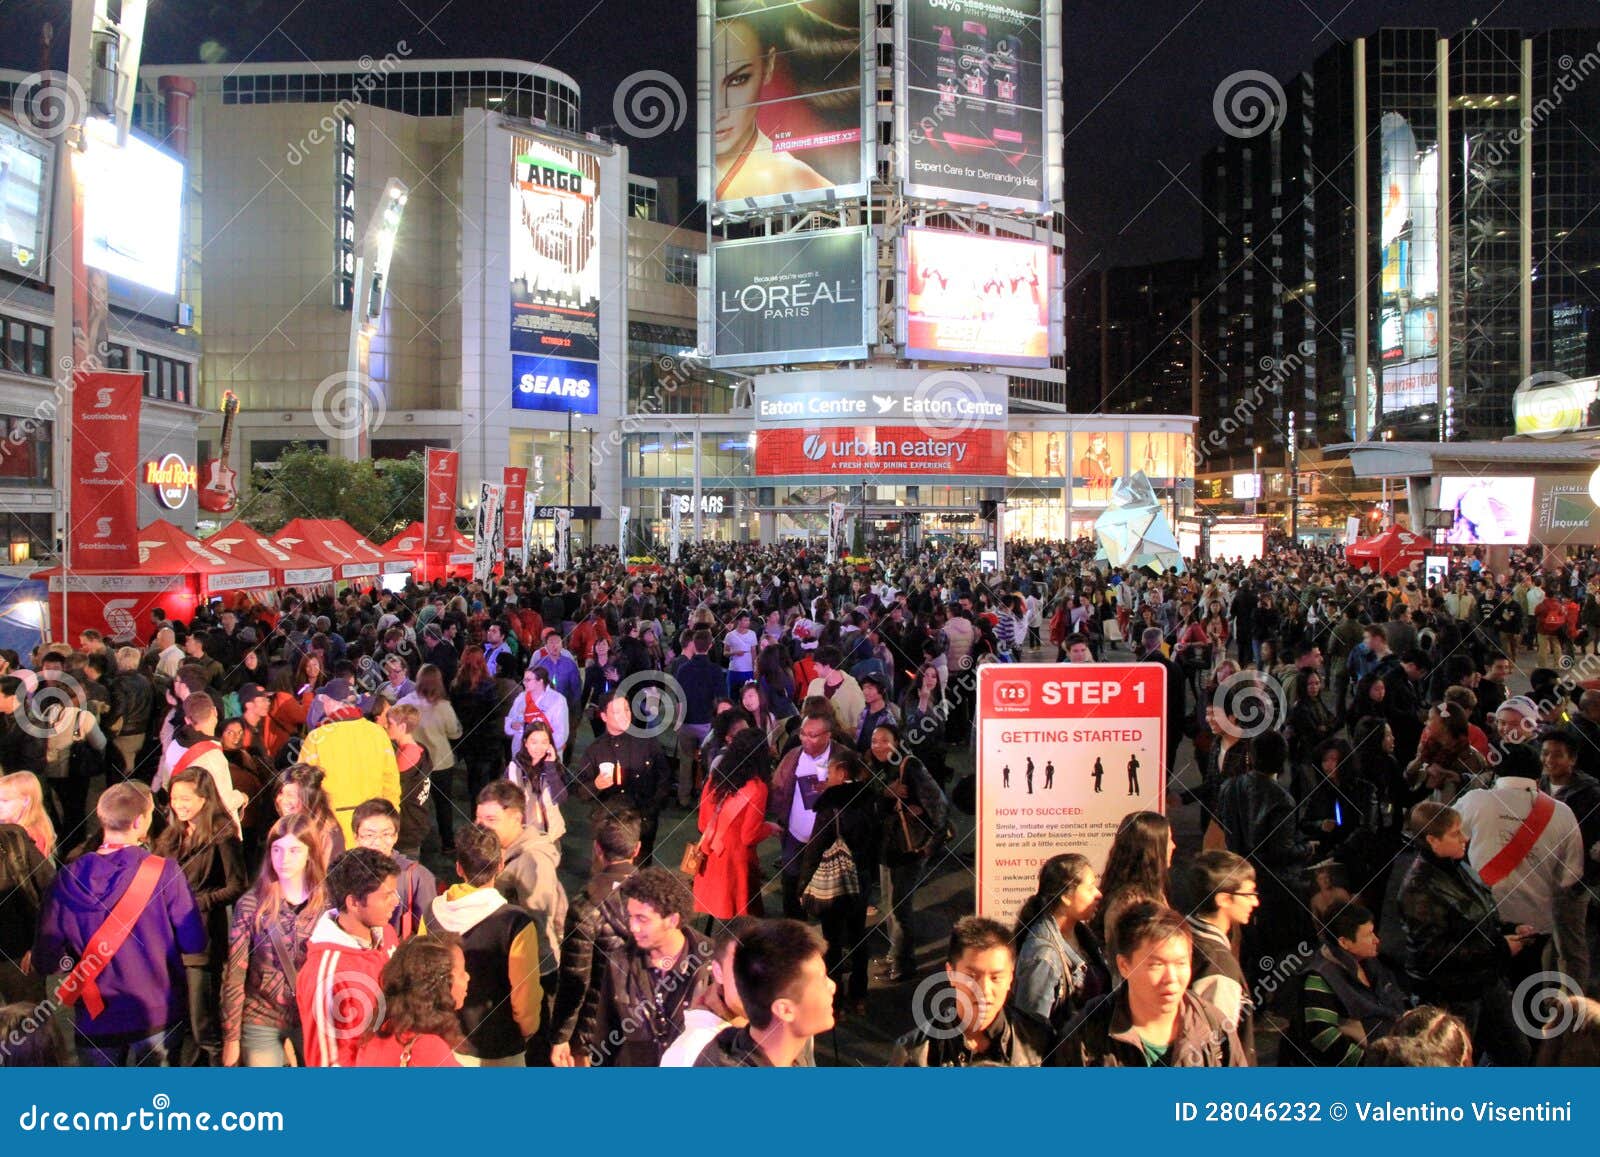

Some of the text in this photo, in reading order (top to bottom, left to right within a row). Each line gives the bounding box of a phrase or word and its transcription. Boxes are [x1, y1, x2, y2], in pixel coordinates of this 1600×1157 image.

[527, 164, 581, 193] ARGO
[914, 160, 1038, 187] Expert Care for Demanding Hair
[345, 124, 355, 273] SEARS
[754, 276, 778, 284] Because
[722, 280, 855, 312] L'ORÉAL
[765, 307, 810, 319] PARIS
[520, 373, 591, 398] SEARS
[760, 397, 866, 416] Eaton Centre
[903, 396, 1003, 416] Eaton Centre
[82, 412, 127, 421] Scotiabank
[832, 437, 967, 462] urban eatery
[80, 477, 124, 486] Scotiabank
[147, 461, 198, 490] Hard Rock
[540, 507, 575, 518] SES
[79, 543, 126, 551] Scotiabank
[1042, 681, 1121, 705] STEP
[1133, 682, 1145, 704] 1
[1001, 730, 1143, 743] GETTING STARTED
[995, 807, 1083, 816] HOW TO SUCCEED:
[995, 859, 1022, 867] WHAT
